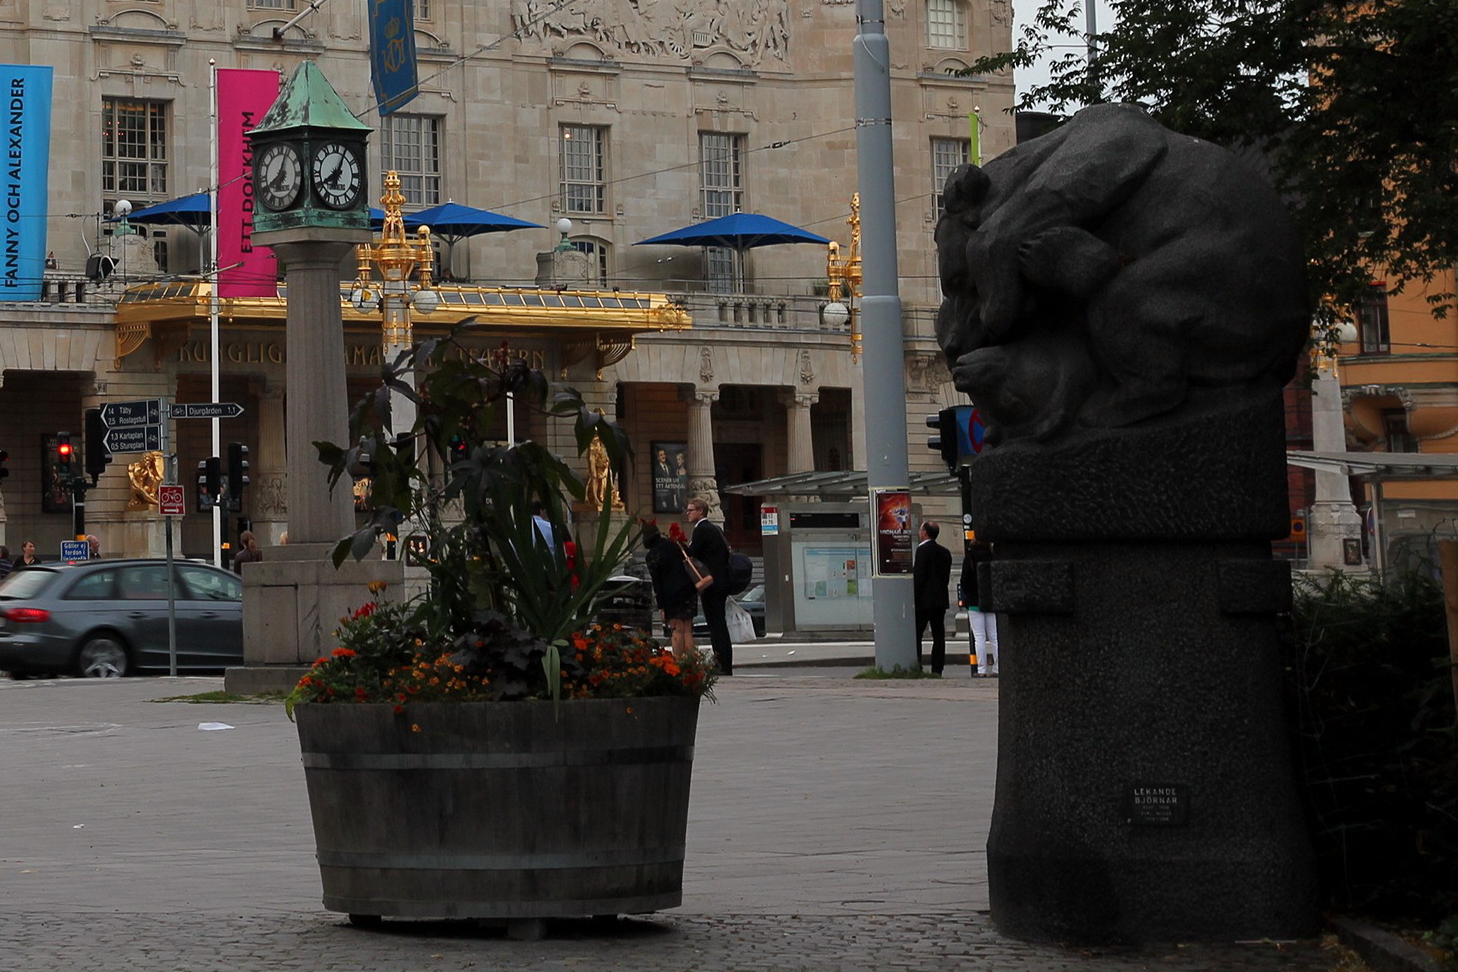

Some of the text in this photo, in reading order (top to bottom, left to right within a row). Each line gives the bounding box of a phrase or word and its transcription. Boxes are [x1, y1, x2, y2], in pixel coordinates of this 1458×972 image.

[4, 77, 25, 288] FANNY OCH ALEXANDER
[179, 341, 283, 364] KUGLIG
[108, 407, 115, 415] 14
[189, 407, 222, 416] Djurgården
[1133, 787, 1177, 796] LEKANDE
[1134, 796, 1178, 804] BJÖRNAR
